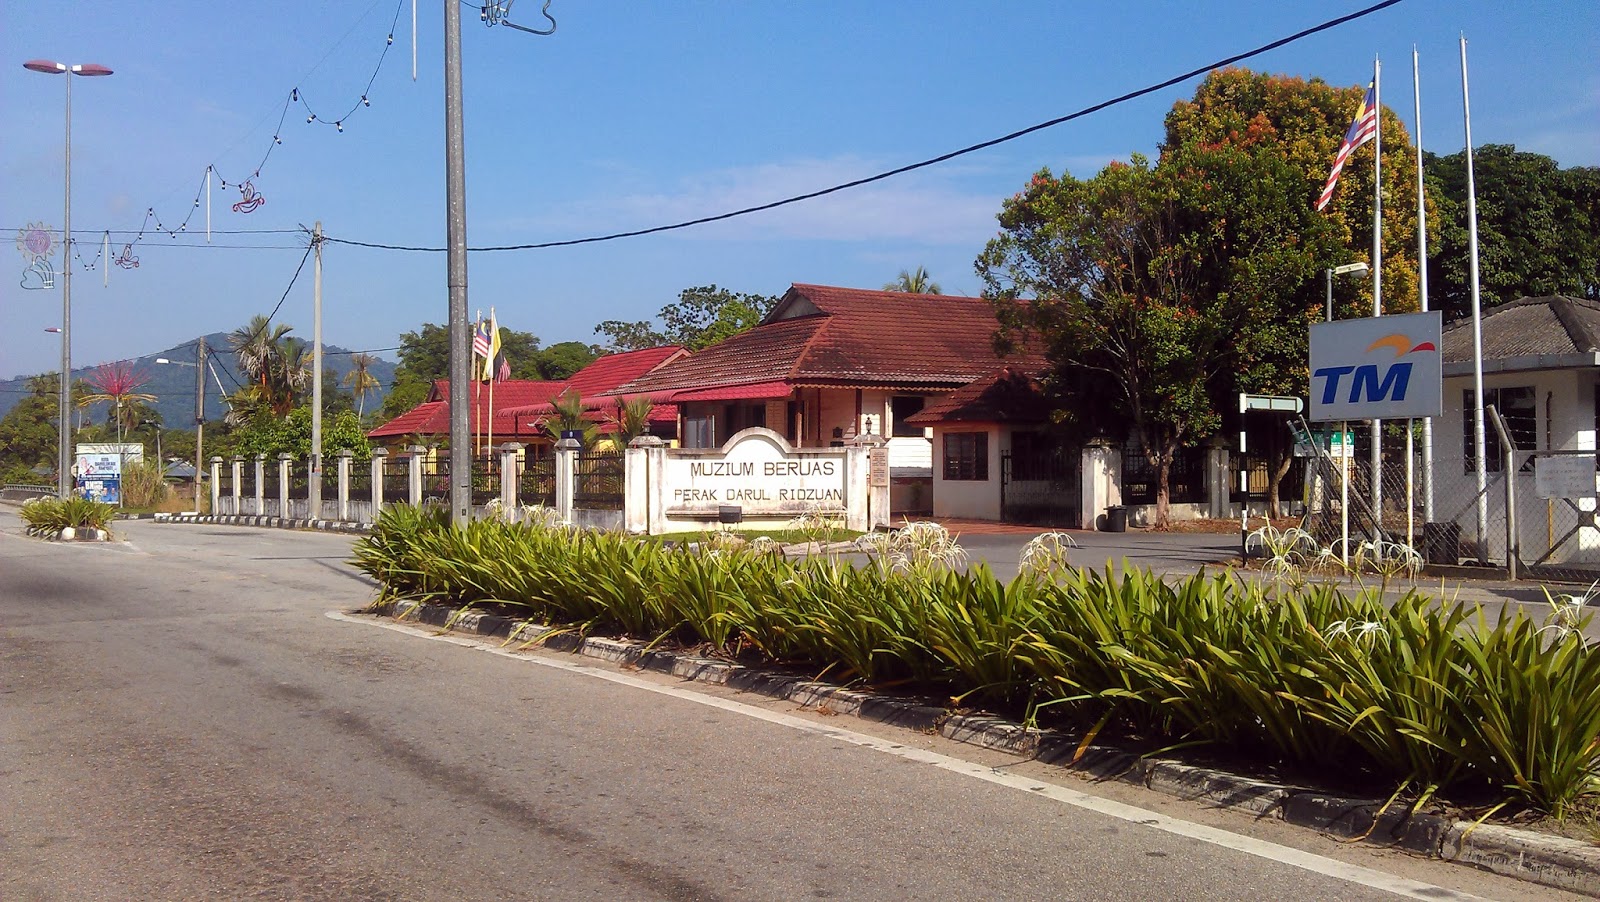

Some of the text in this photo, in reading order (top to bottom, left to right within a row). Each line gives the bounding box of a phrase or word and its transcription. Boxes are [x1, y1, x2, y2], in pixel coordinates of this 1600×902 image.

[1313, 362, 1414, 405] TM
[690, 461, 835, 476] MUZIUM BERUAS
[674, 488, 843, 501] PERAK DARUL RIDZUAN
